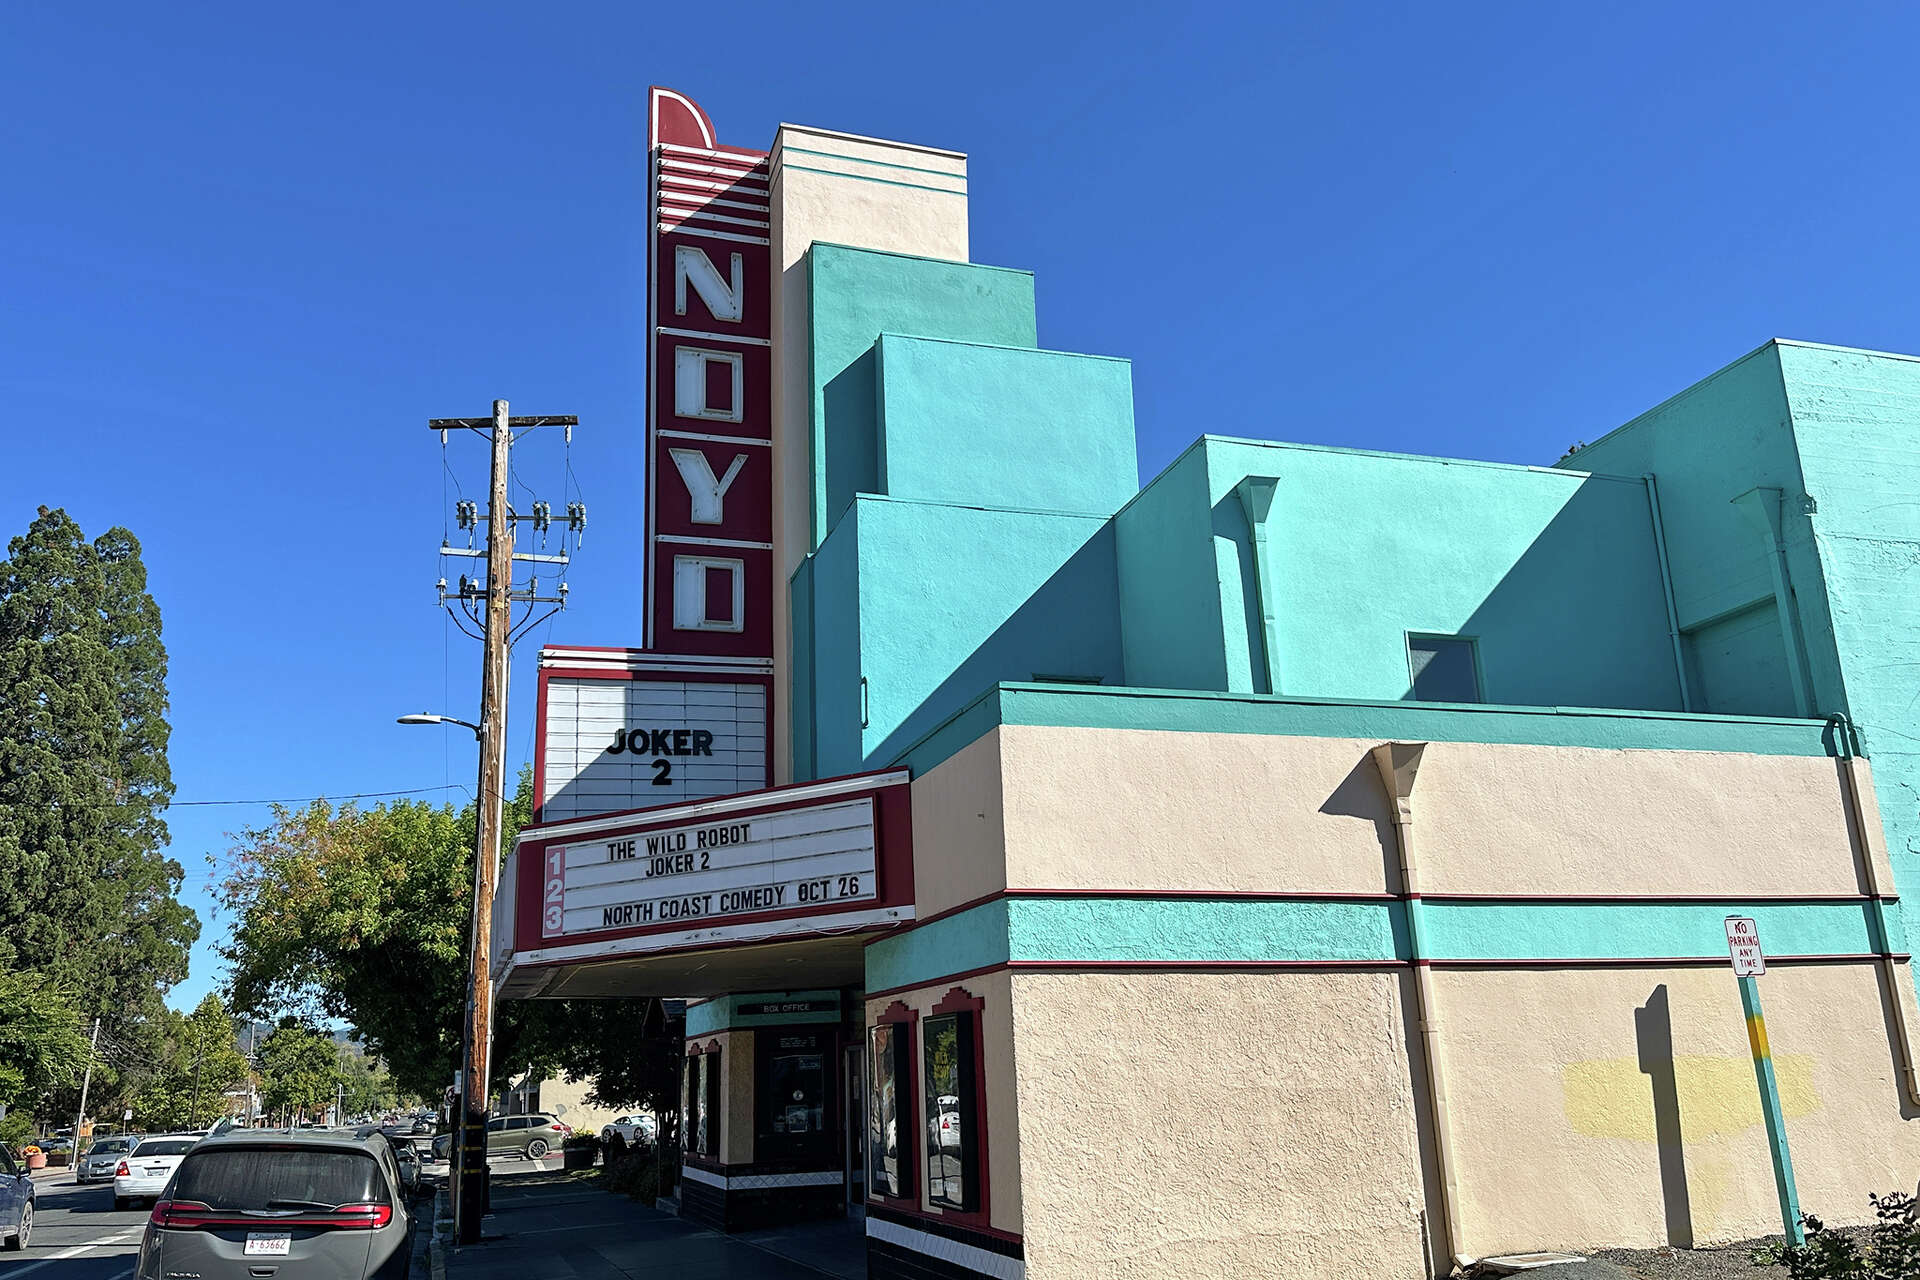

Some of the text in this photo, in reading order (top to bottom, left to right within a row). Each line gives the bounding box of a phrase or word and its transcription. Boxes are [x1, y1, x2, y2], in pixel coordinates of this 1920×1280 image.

[669, 244, 749, 634] NOYO
[606, 728, 713, 756] JOKER
[651, 758, 672, 786] 2
[607, 823, 750, 861] THE WILD ROBOT
[549, 851, 561, 875] 1
[645, 851, 710, 877] JOKER 2
[547, 878, 563, 903] 2
[603, 876, 860, 926] NORTH COAST COMEDY OCT 26
[545, 905, 562, 930] 3
[1734, 921, 1748, 934] NO
[1729, 935, 1758, 947] PARKING
[1739, 948, 1753, 957] ANY
[1739, 958, 1757, 968] TIME
[763, 1003, 810, 1013] BOX OFFICE
